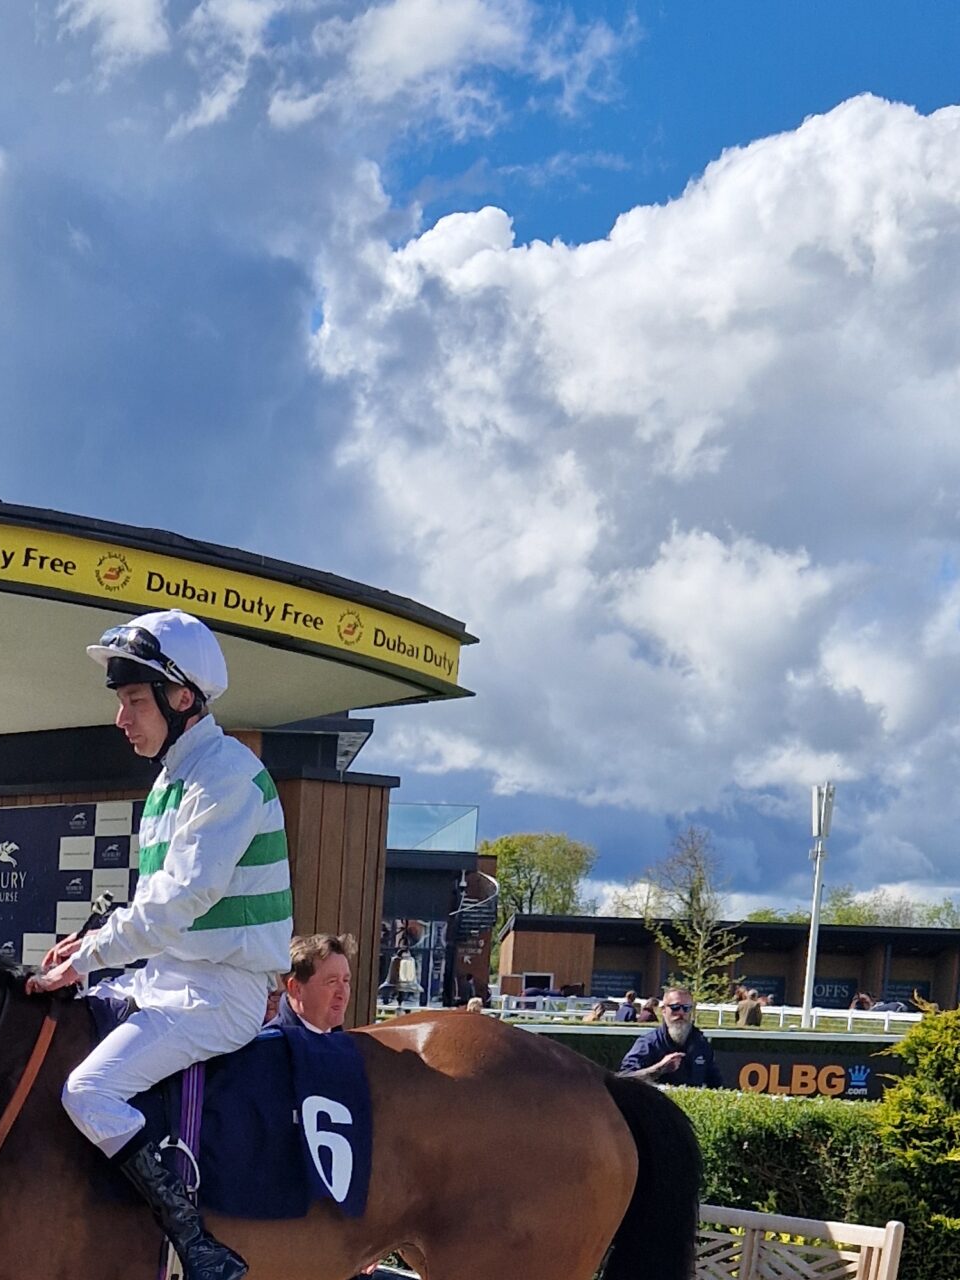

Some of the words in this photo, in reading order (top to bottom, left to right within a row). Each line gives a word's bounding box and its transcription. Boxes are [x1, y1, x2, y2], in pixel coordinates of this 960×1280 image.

[23, 547, 77, 575] Free
[146, 571, 217, 605] Dubai
[224, 588, 276, 623] Duty
[281, 602, 324, 630] Free
[373, 627, 419, 659] Dubai
[423, 644, 455, 676] Duty
[814, 983, 849, 998] OFFS
[739, 1062, 845, 1096] OLBG
[845, 1087, 868, 1095] .com
[302, 1095, 353, 1202] 6
